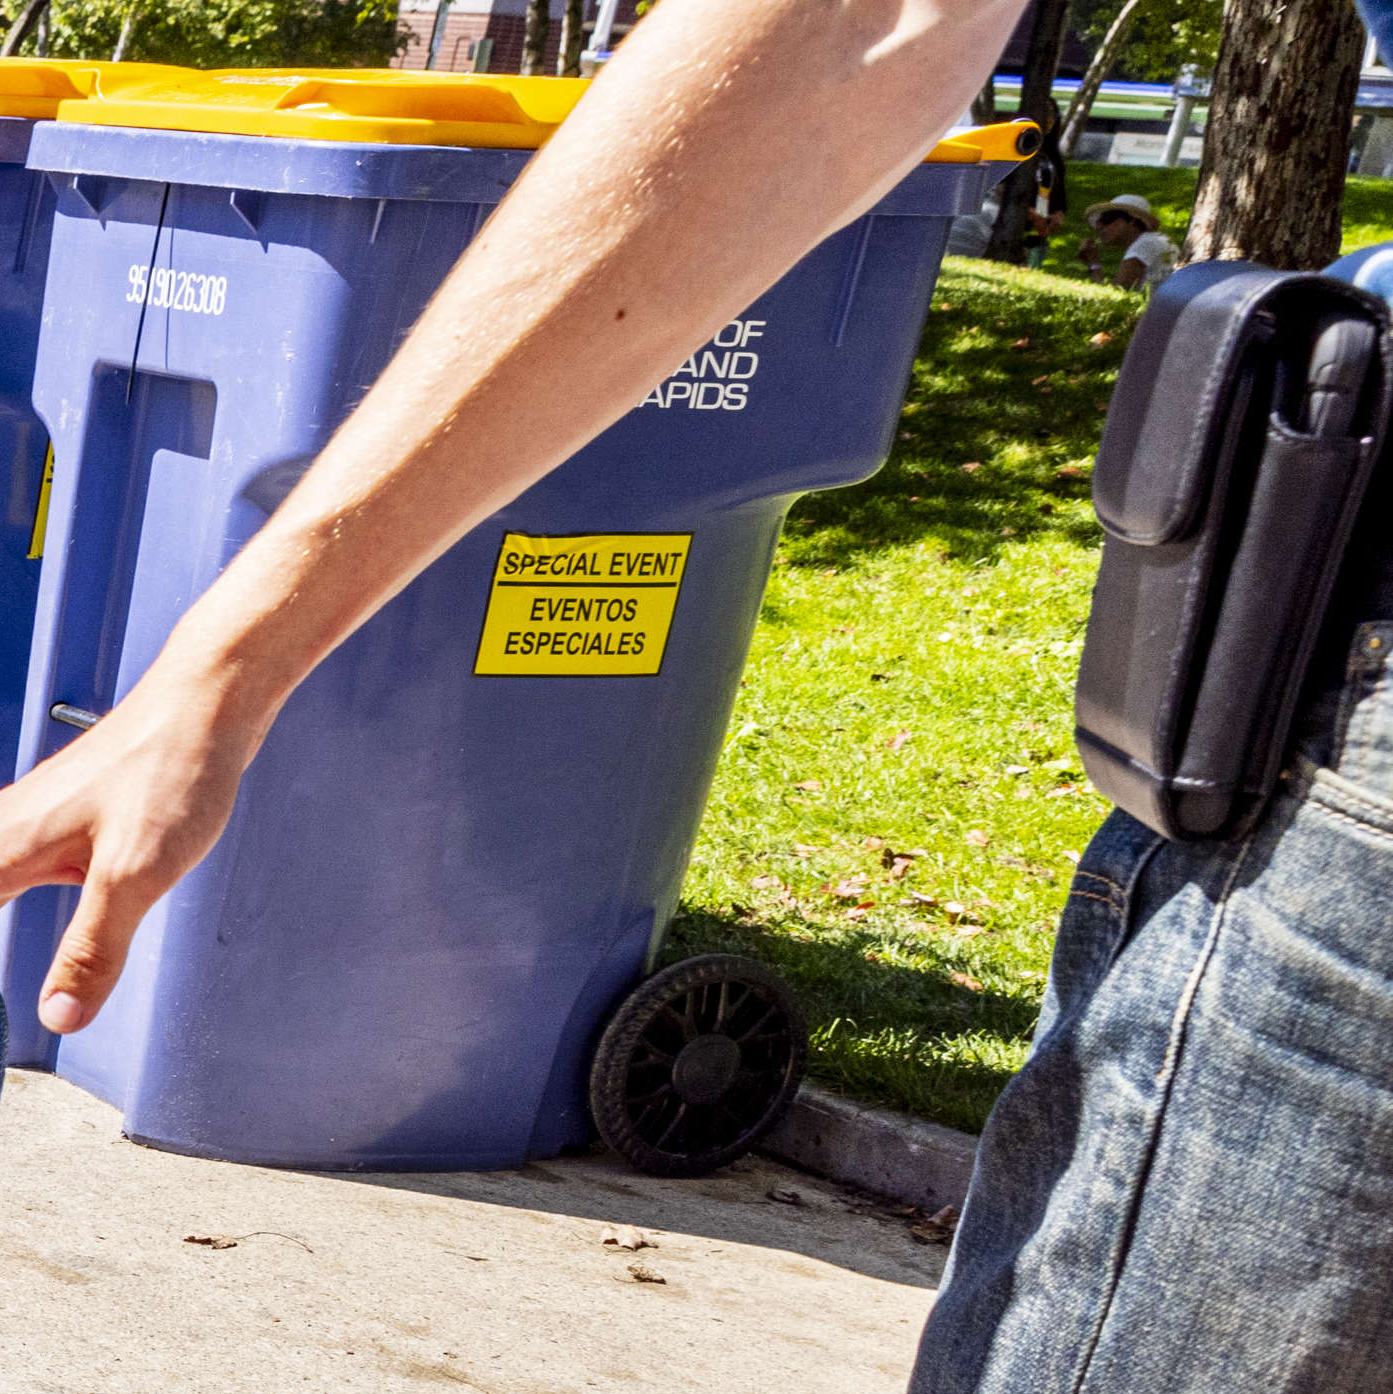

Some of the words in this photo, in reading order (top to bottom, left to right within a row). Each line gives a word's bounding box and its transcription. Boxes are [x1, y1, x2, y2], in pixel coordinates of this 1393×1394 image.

[125, 264, 227, 315] 9519026308
[714, 320, 767, 347] OF
[672, 351, 759, 379] AND
[635, 381, 749, 410] APIDS
[503, 552, 602, 576] SPECIAL
[609, 552, 682, 576] EVENT
[529, 598, 638, 622] EVENTOS
[504, 631, 646, 656] ESPECIALES
